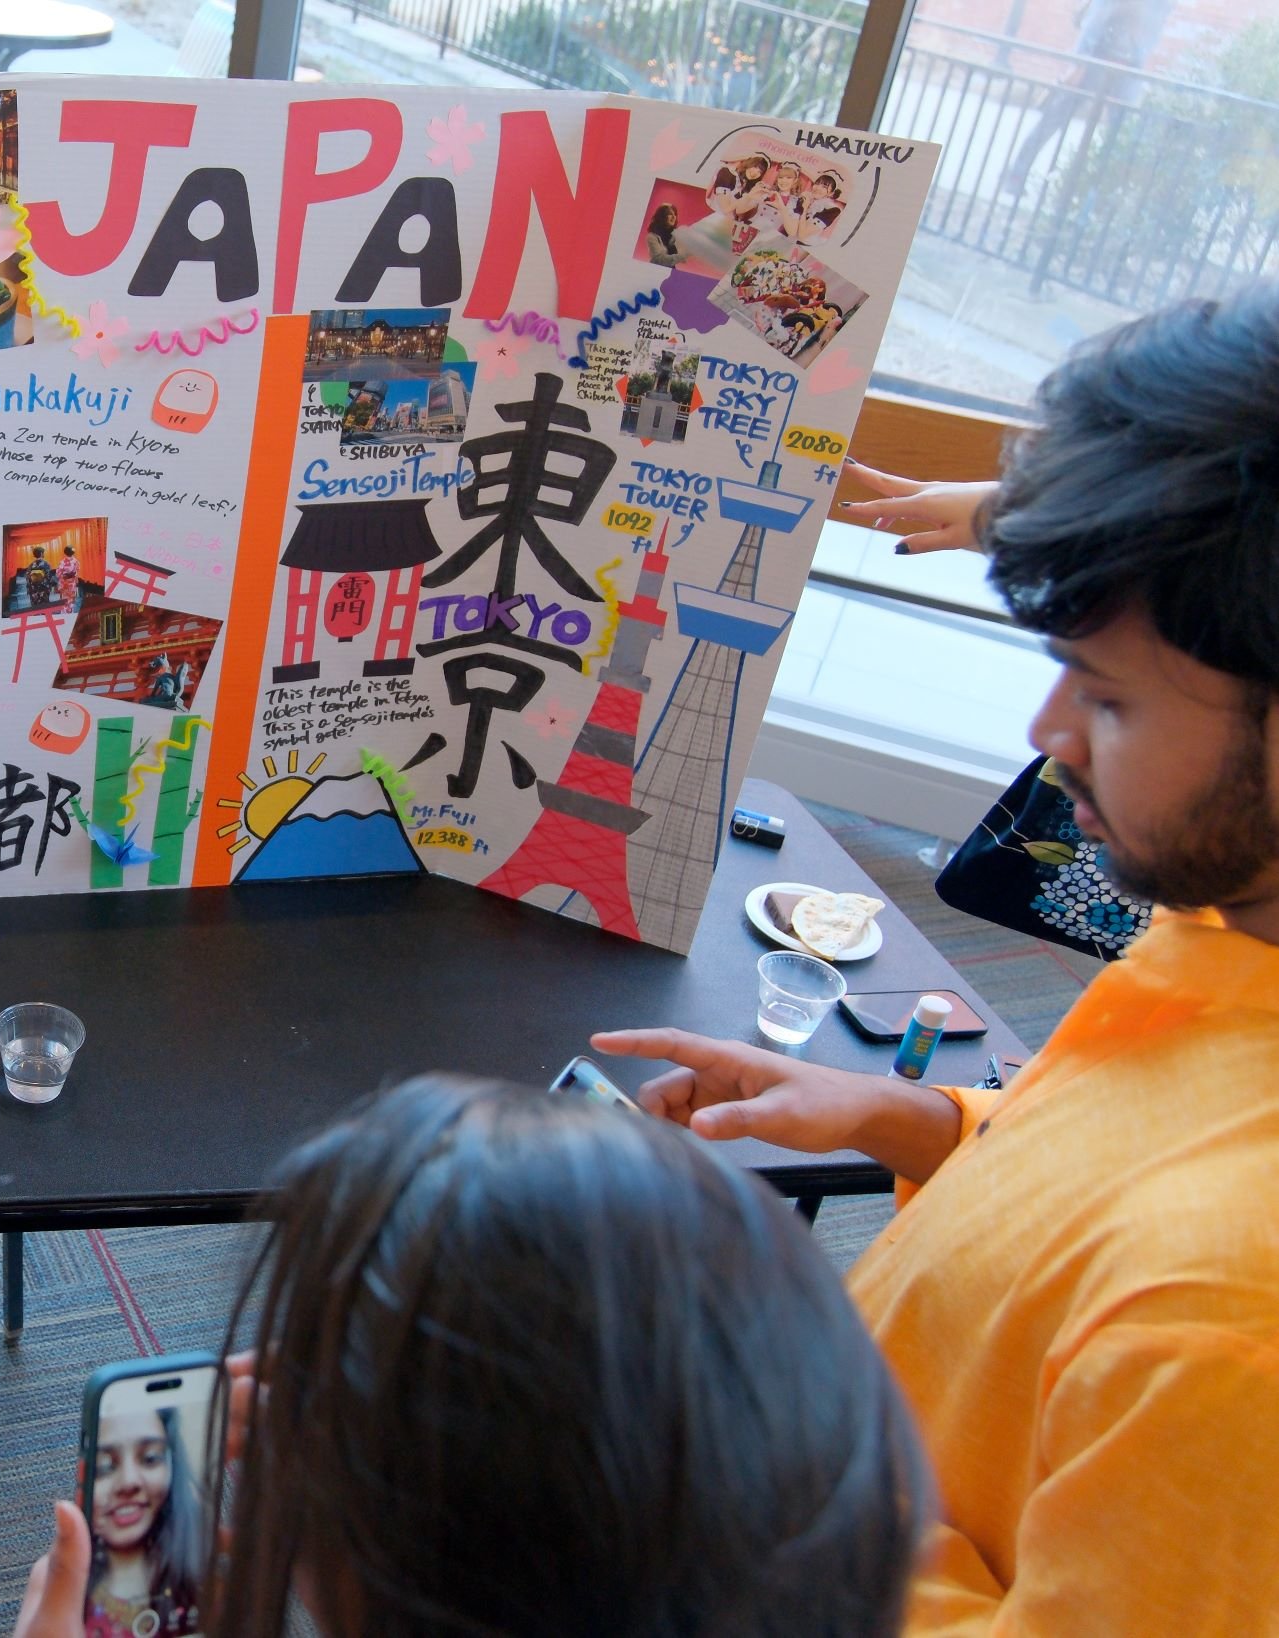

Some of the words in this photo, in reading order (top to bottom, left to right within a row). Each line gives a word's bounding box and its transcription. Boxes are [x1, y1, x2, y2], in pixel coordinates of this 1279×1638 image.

[795, 129, 914, 163] HARAJUKU
[23, 98, 631, 322] JAPAN
[700, 355, 796, 393] TOKYO
[717, 388, 778, 416] SKY
[698, 406, 772, 440] TREE
[14, 427, 44, 443] Zen
[52, 434, 98, 451] temple
[108, 437, 122, 448] in
[348, 443, 426, 461] SHIBUYA
[785, 431, 843, 456] 2080
[44, 453, 67, 467] top
[75, 459, 107, 473] two
[111, 459, 163, 480] floors
[403, 452, 475, 498] Temple
[630, 461, 712, 495] TOKYO
[814, 464, 838, 485] ft
[4, 469, 76, 491] completely
[76, 480, 129, 498] covered
[135, 487, 148, 498] in
[148, 490, 185, 506] gold
[192, 494, 237, 518] leaf!
[619, 483, 708, 523] TOWER
[607, 509, 652, 532] 1092
[631, 536, 652, 554] ft
[397, 372, 617, 798] 東京
[330, 576, 370, 626] 雷門
[418, 592, 592, 646] TOKYO
[265, 688, 303, 705] This
[309, 679, 361, 701] temple
[367, 681, 381, 693] is
[386, 677, 410, 692] the
[263, 703, 316, 721] oldest
[319, 696, 368, 713] temple
[374, 696, 388, 707] in
[263, 722, 296, 736] This
[302, 719, 314, 729] is
[318, 720, 330, 728] a
[264, 730, 310, 750] symbol
[417, 830, 469, 848] 12.388
[473, 838, 489, 856] ft
